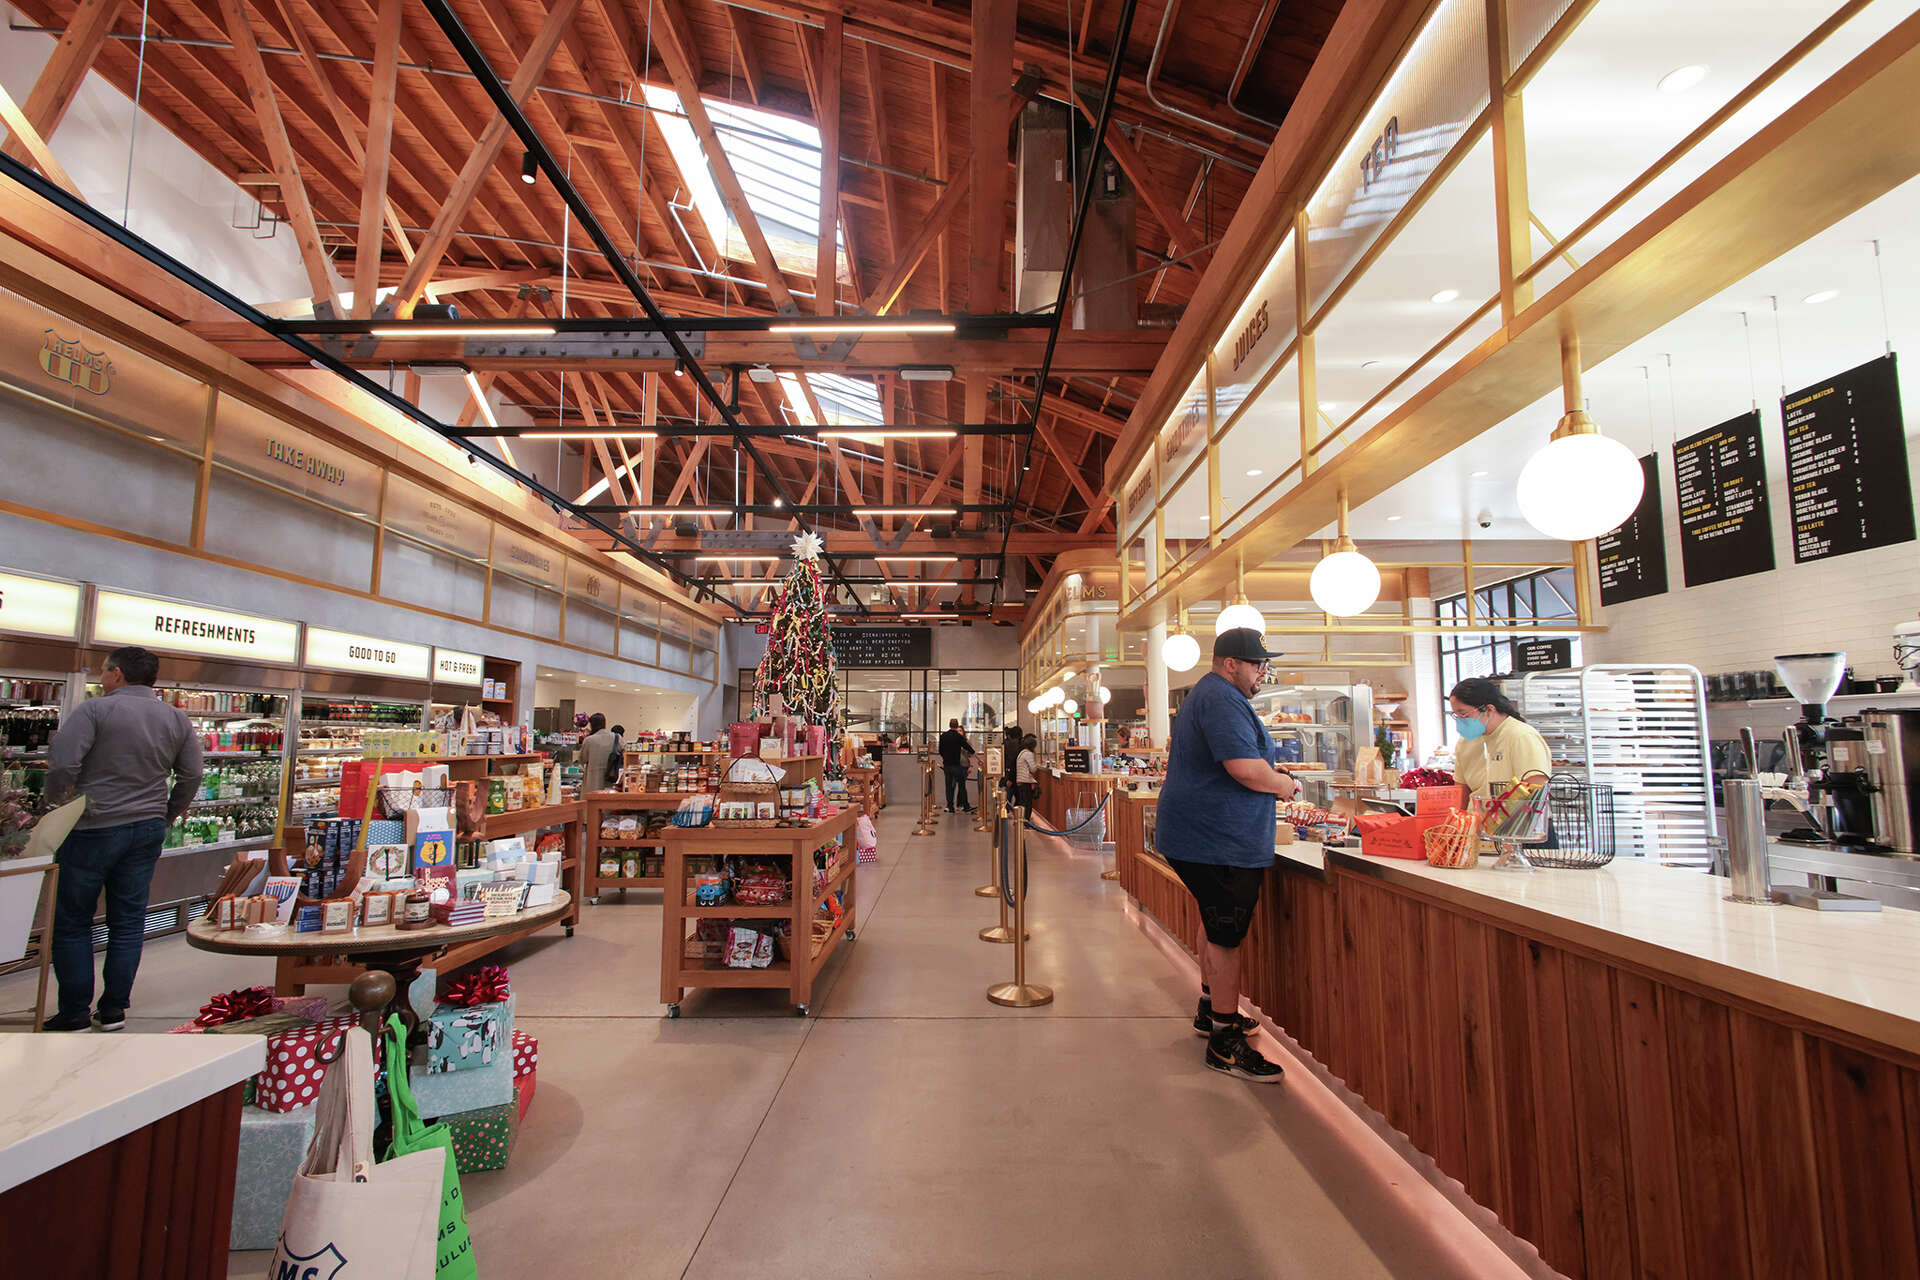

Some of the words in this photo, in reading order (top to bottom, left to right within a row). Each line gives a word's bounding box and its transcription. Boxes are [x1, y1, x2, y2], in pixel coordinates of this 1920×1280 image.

[1360, 116, 1399, 194] TEA
[1233, 300, 1269, 372] JUICES
[53, 341, 103, 372] HELMS
[1787, 409, 1802, 419] LATTE
[1815, 433, 1832, 444] BLACK
[266, 439, 304, 469] TAKE
[307, 456, 345, 486] AWAY
[1811, 487, 1829, 495] BLACK
[1816, 507, 1839, 518] PALMER
[1808, 520, 1825, 529] LATTE
[1799, 542, 1820, 552] MATCHA
[1800, 547, 1830, 558] CHOCOLATE
[155, 615, 255, 644] REFRESHMENTS
[349, 646, 372, 660] GOOD
[374, 649, 384, 662] TO
[385, 652, 396, 664] GO
[440, 660, 452, 671] HOT
[453, 662, 458, 672] &
[459, 663, 477, 675] FRESH
